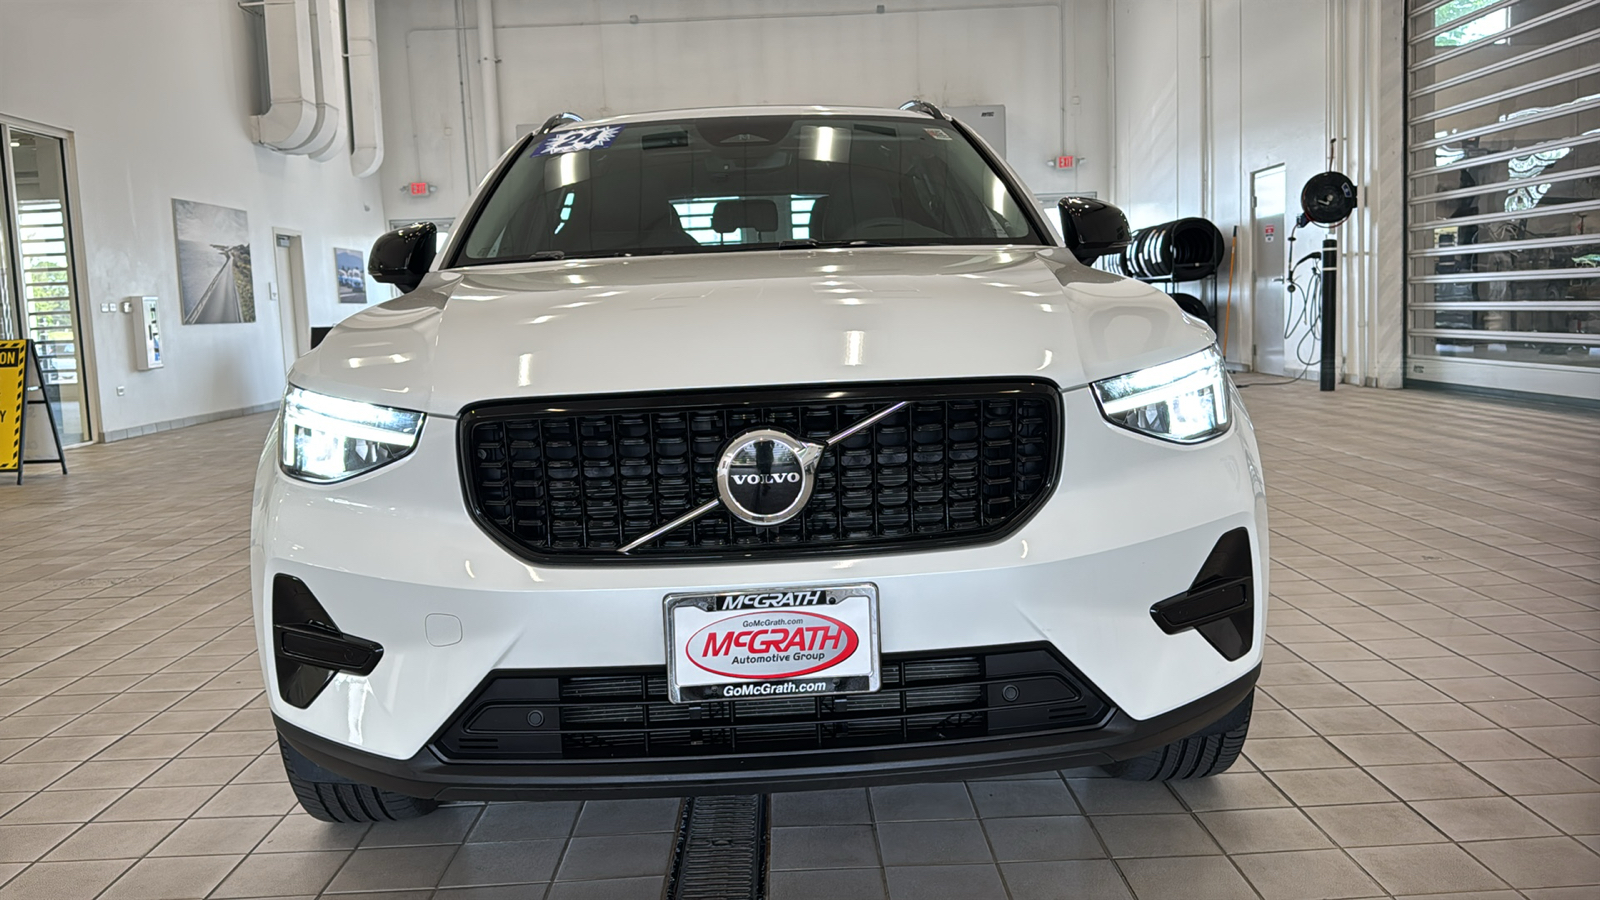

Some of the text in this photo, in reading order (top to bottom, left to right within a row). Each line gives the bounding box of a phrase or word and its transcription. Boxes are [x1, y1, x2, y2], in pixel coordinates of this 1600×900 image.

[730, 472, 800, 485] VOLVO
[742, 618, 804, 628] GoMcGrath.com
[731, 652, 825, 665] Automotive Group
[723, 681, 827, 697] GoMcGrath.com
